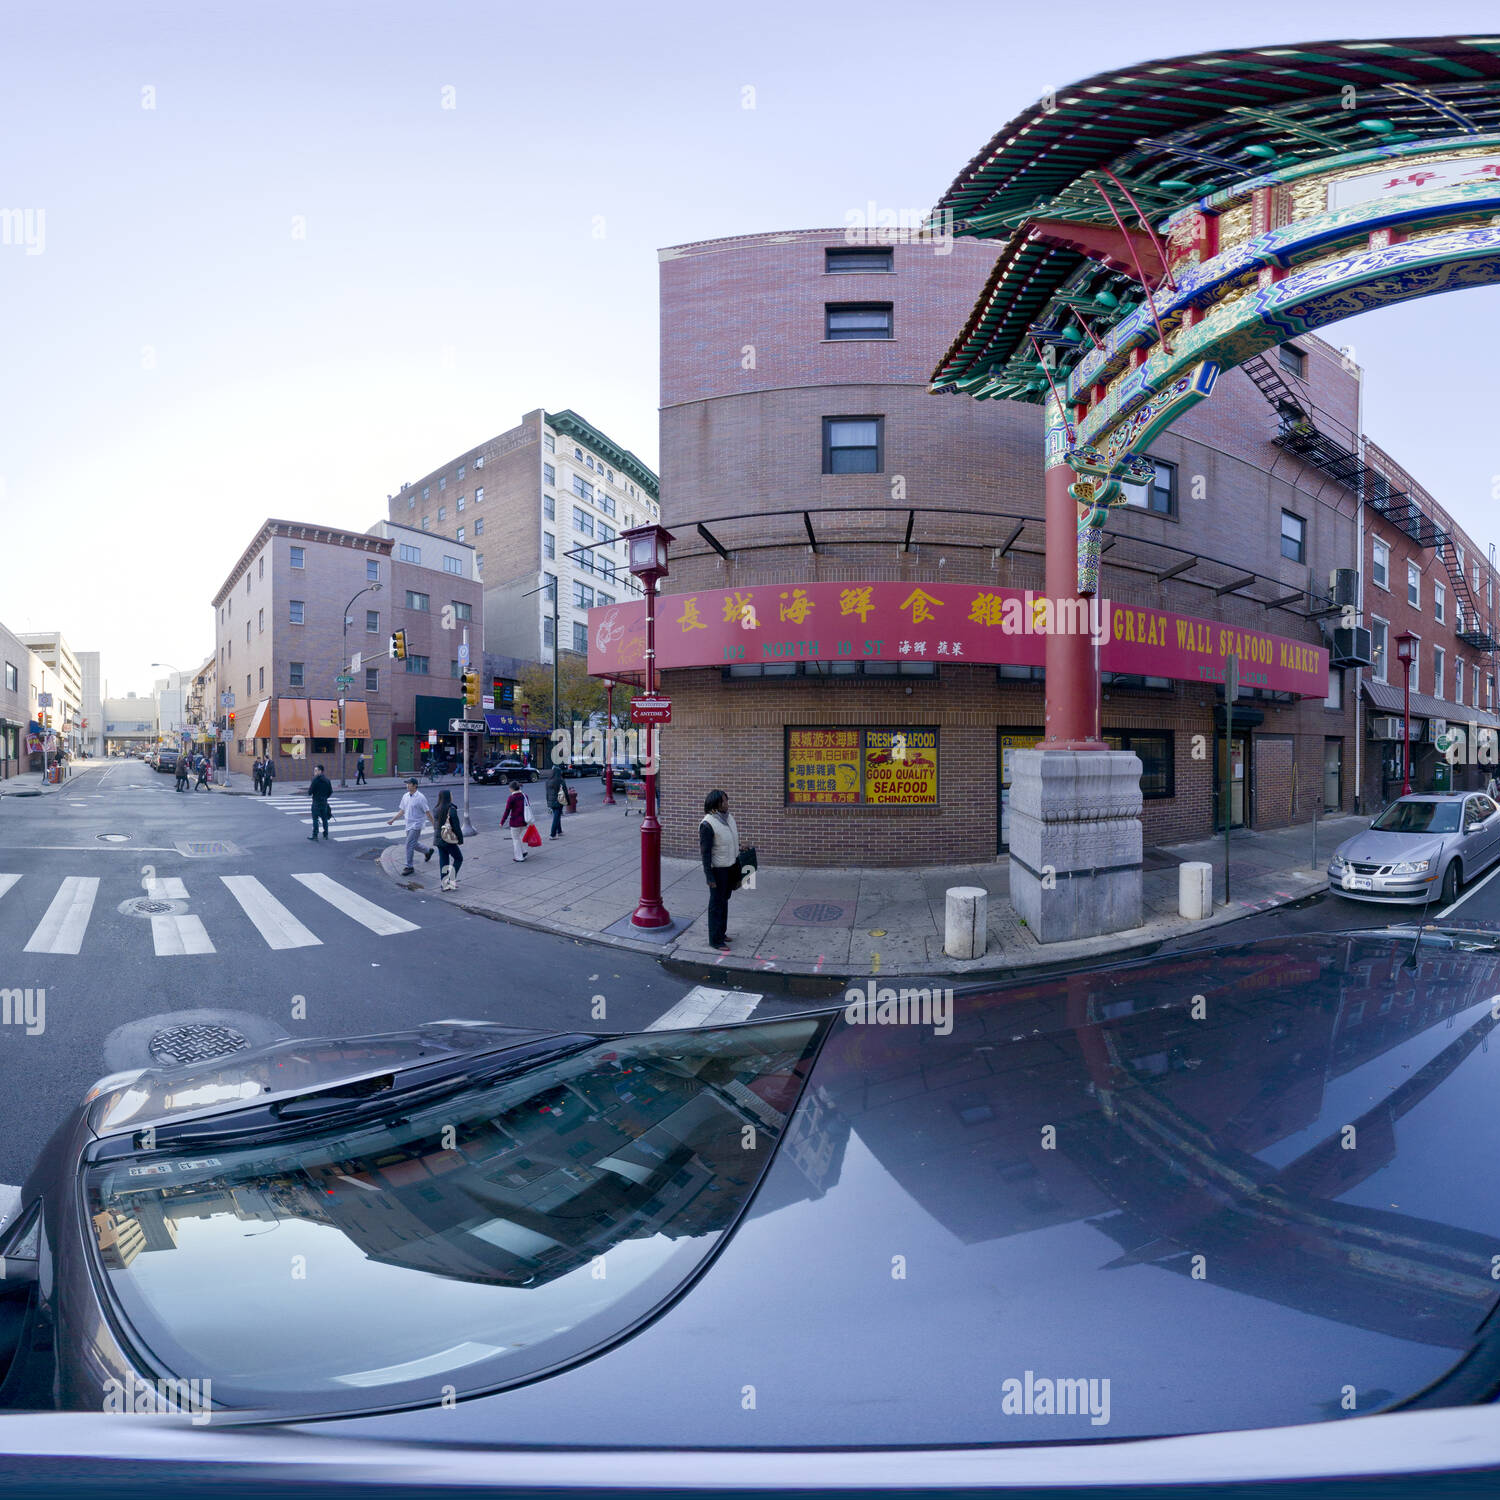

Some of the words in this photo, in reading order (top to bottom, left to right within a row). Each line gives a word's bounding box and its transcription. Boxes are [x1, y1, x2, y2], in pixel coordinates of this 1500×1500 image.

[1113, 608, 1167, 647] GREAT
[1176, 619, 1213, 654] WALL
[1219, 629, 1273, 665] SEAFOOD
[1279, 642, 1320, 675] MARKET
[723, 645, 746, 660] 102
[762, 640, 820, 658] NORTH
[837, 640, 852, 656] 10
[863, 639, 885, 656] ST
[866, 731, 893, 747] FRESH
[866, 769, 892, 780] GOOD
[896, 769, 936, 781] QUALITY
[873, 782, 928, 793] SEAFOOD
[866, 795, 874, 803] in
[878, 795, 936, 803] CHINATOWN
